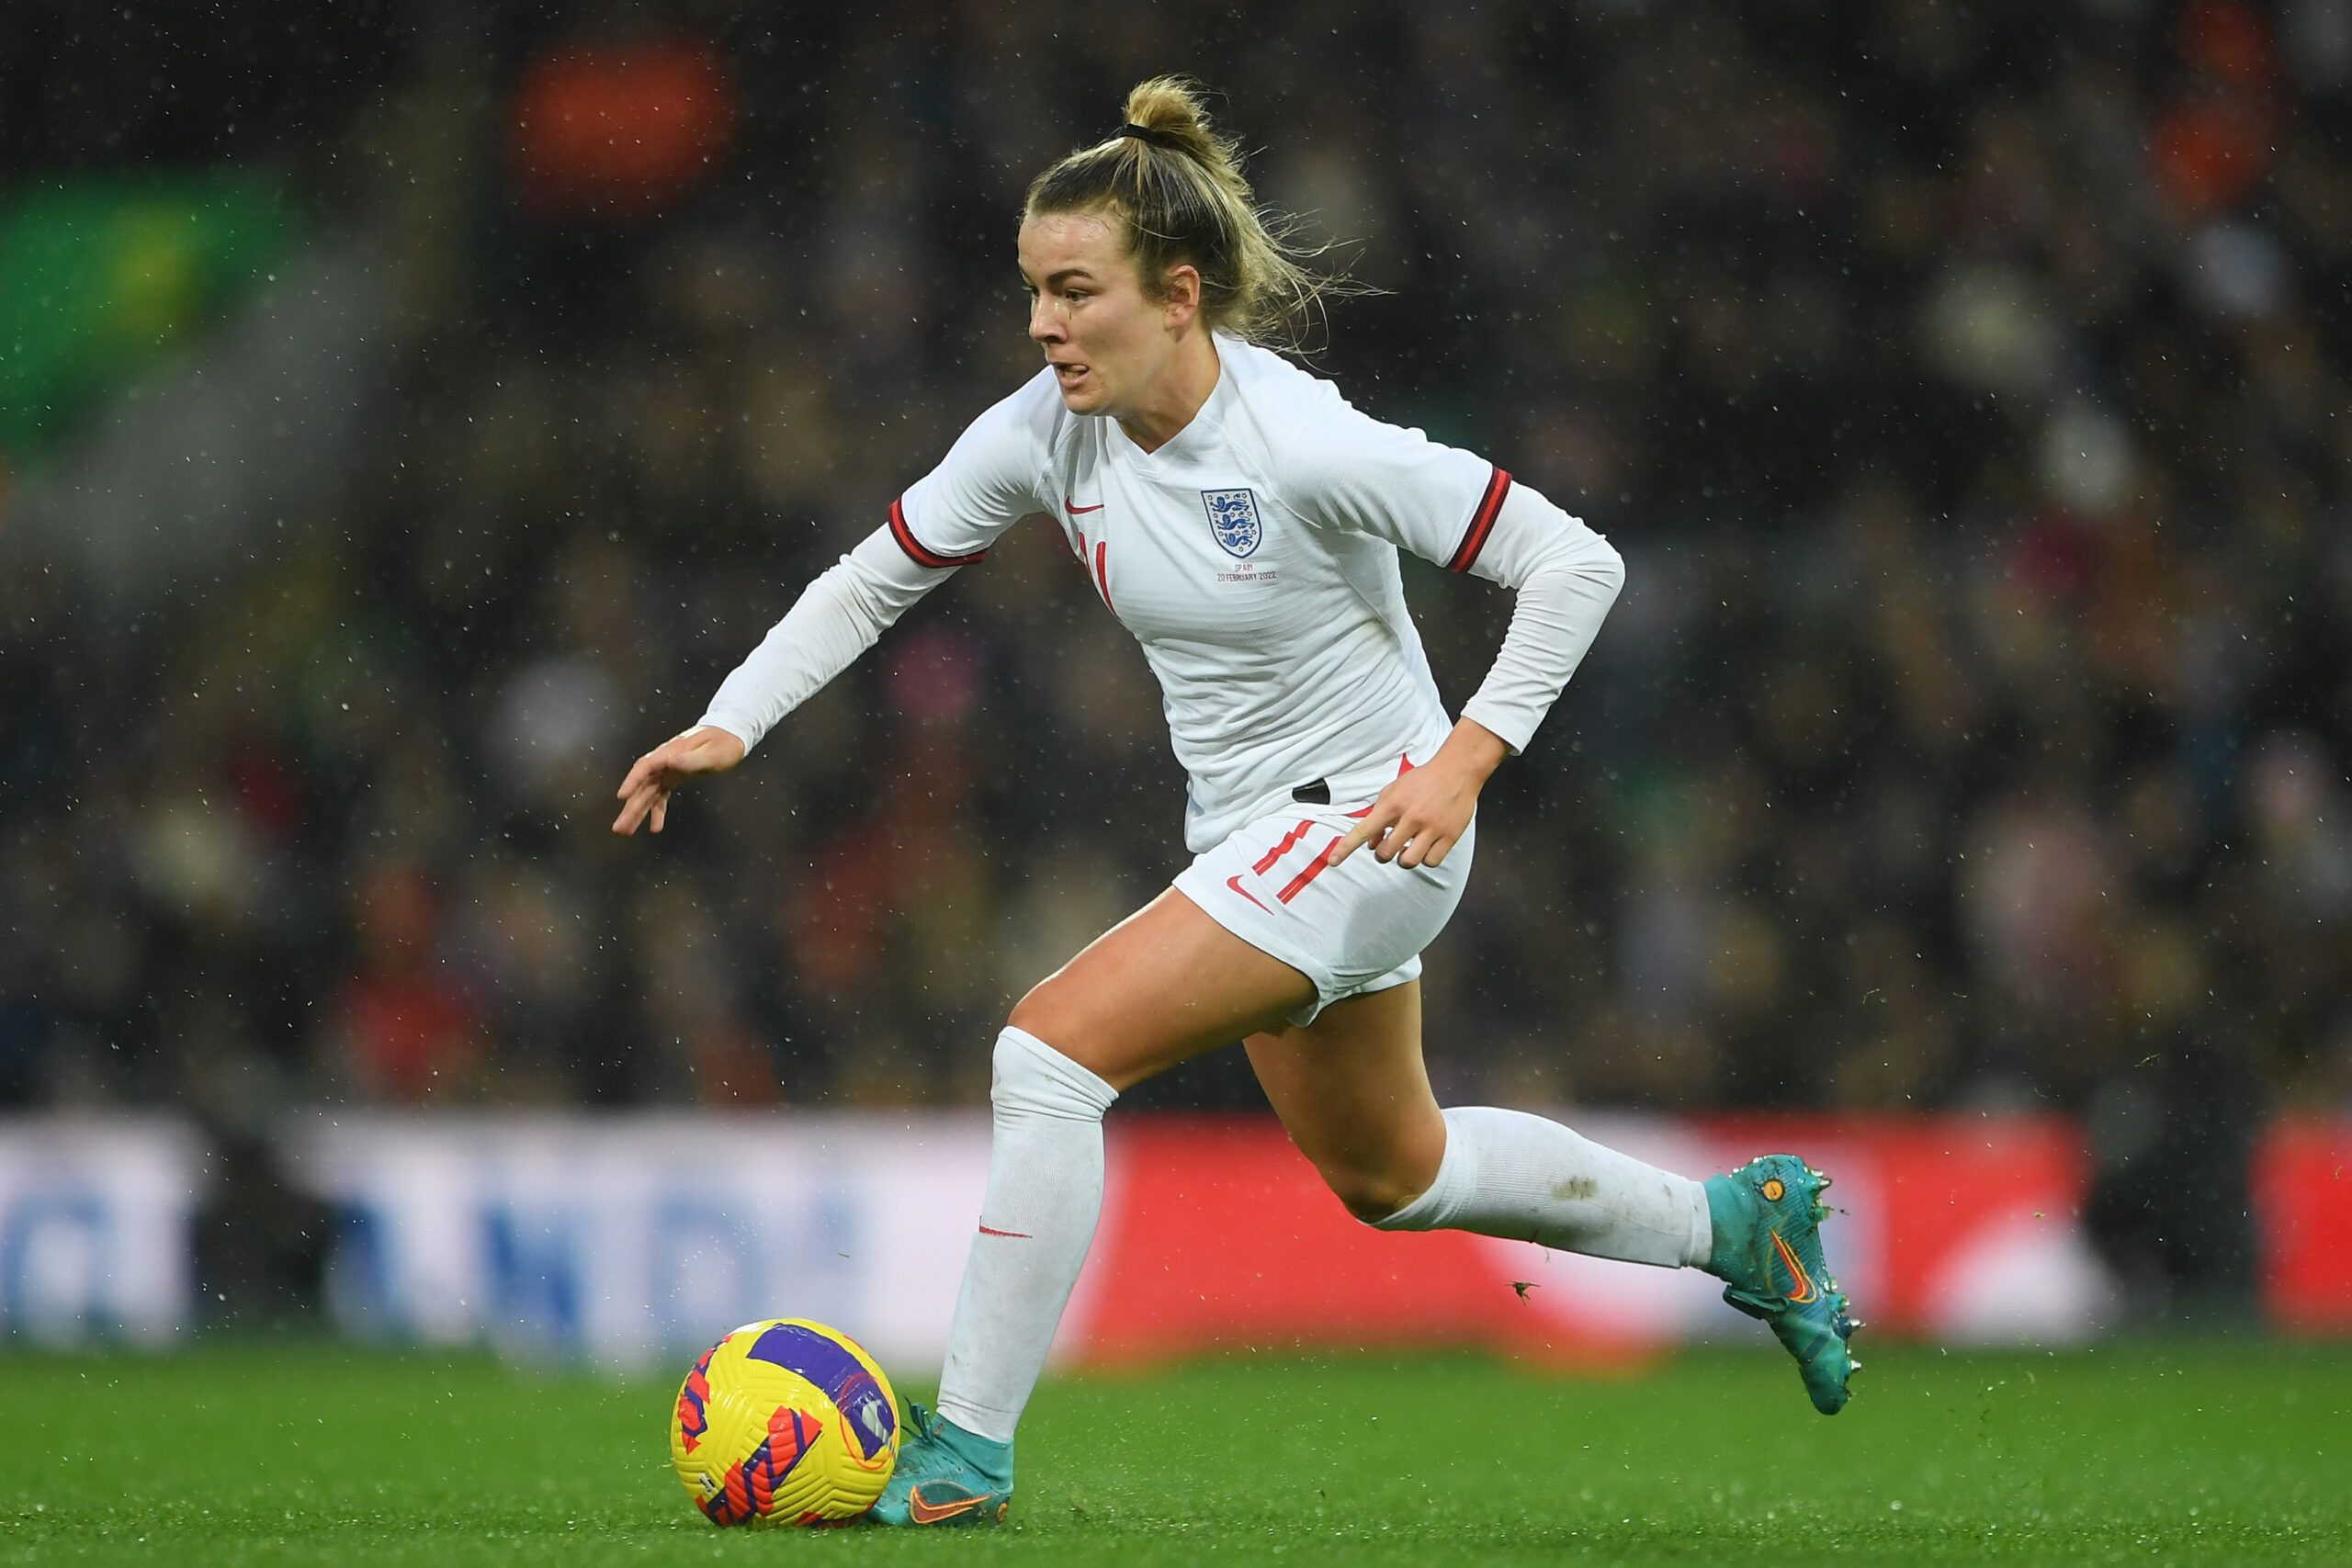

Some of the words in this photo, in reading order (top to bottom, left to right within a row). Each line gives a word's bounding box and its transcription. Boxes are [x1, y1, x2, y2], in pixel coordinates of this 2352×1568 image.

[1235, 564, 1253, 572] SPAIN
[1226, 573, 1257, 581] FEBRUARY
[1259, 571, 1277, 580] 2022
[1251, 819, 1345, 906] 11
